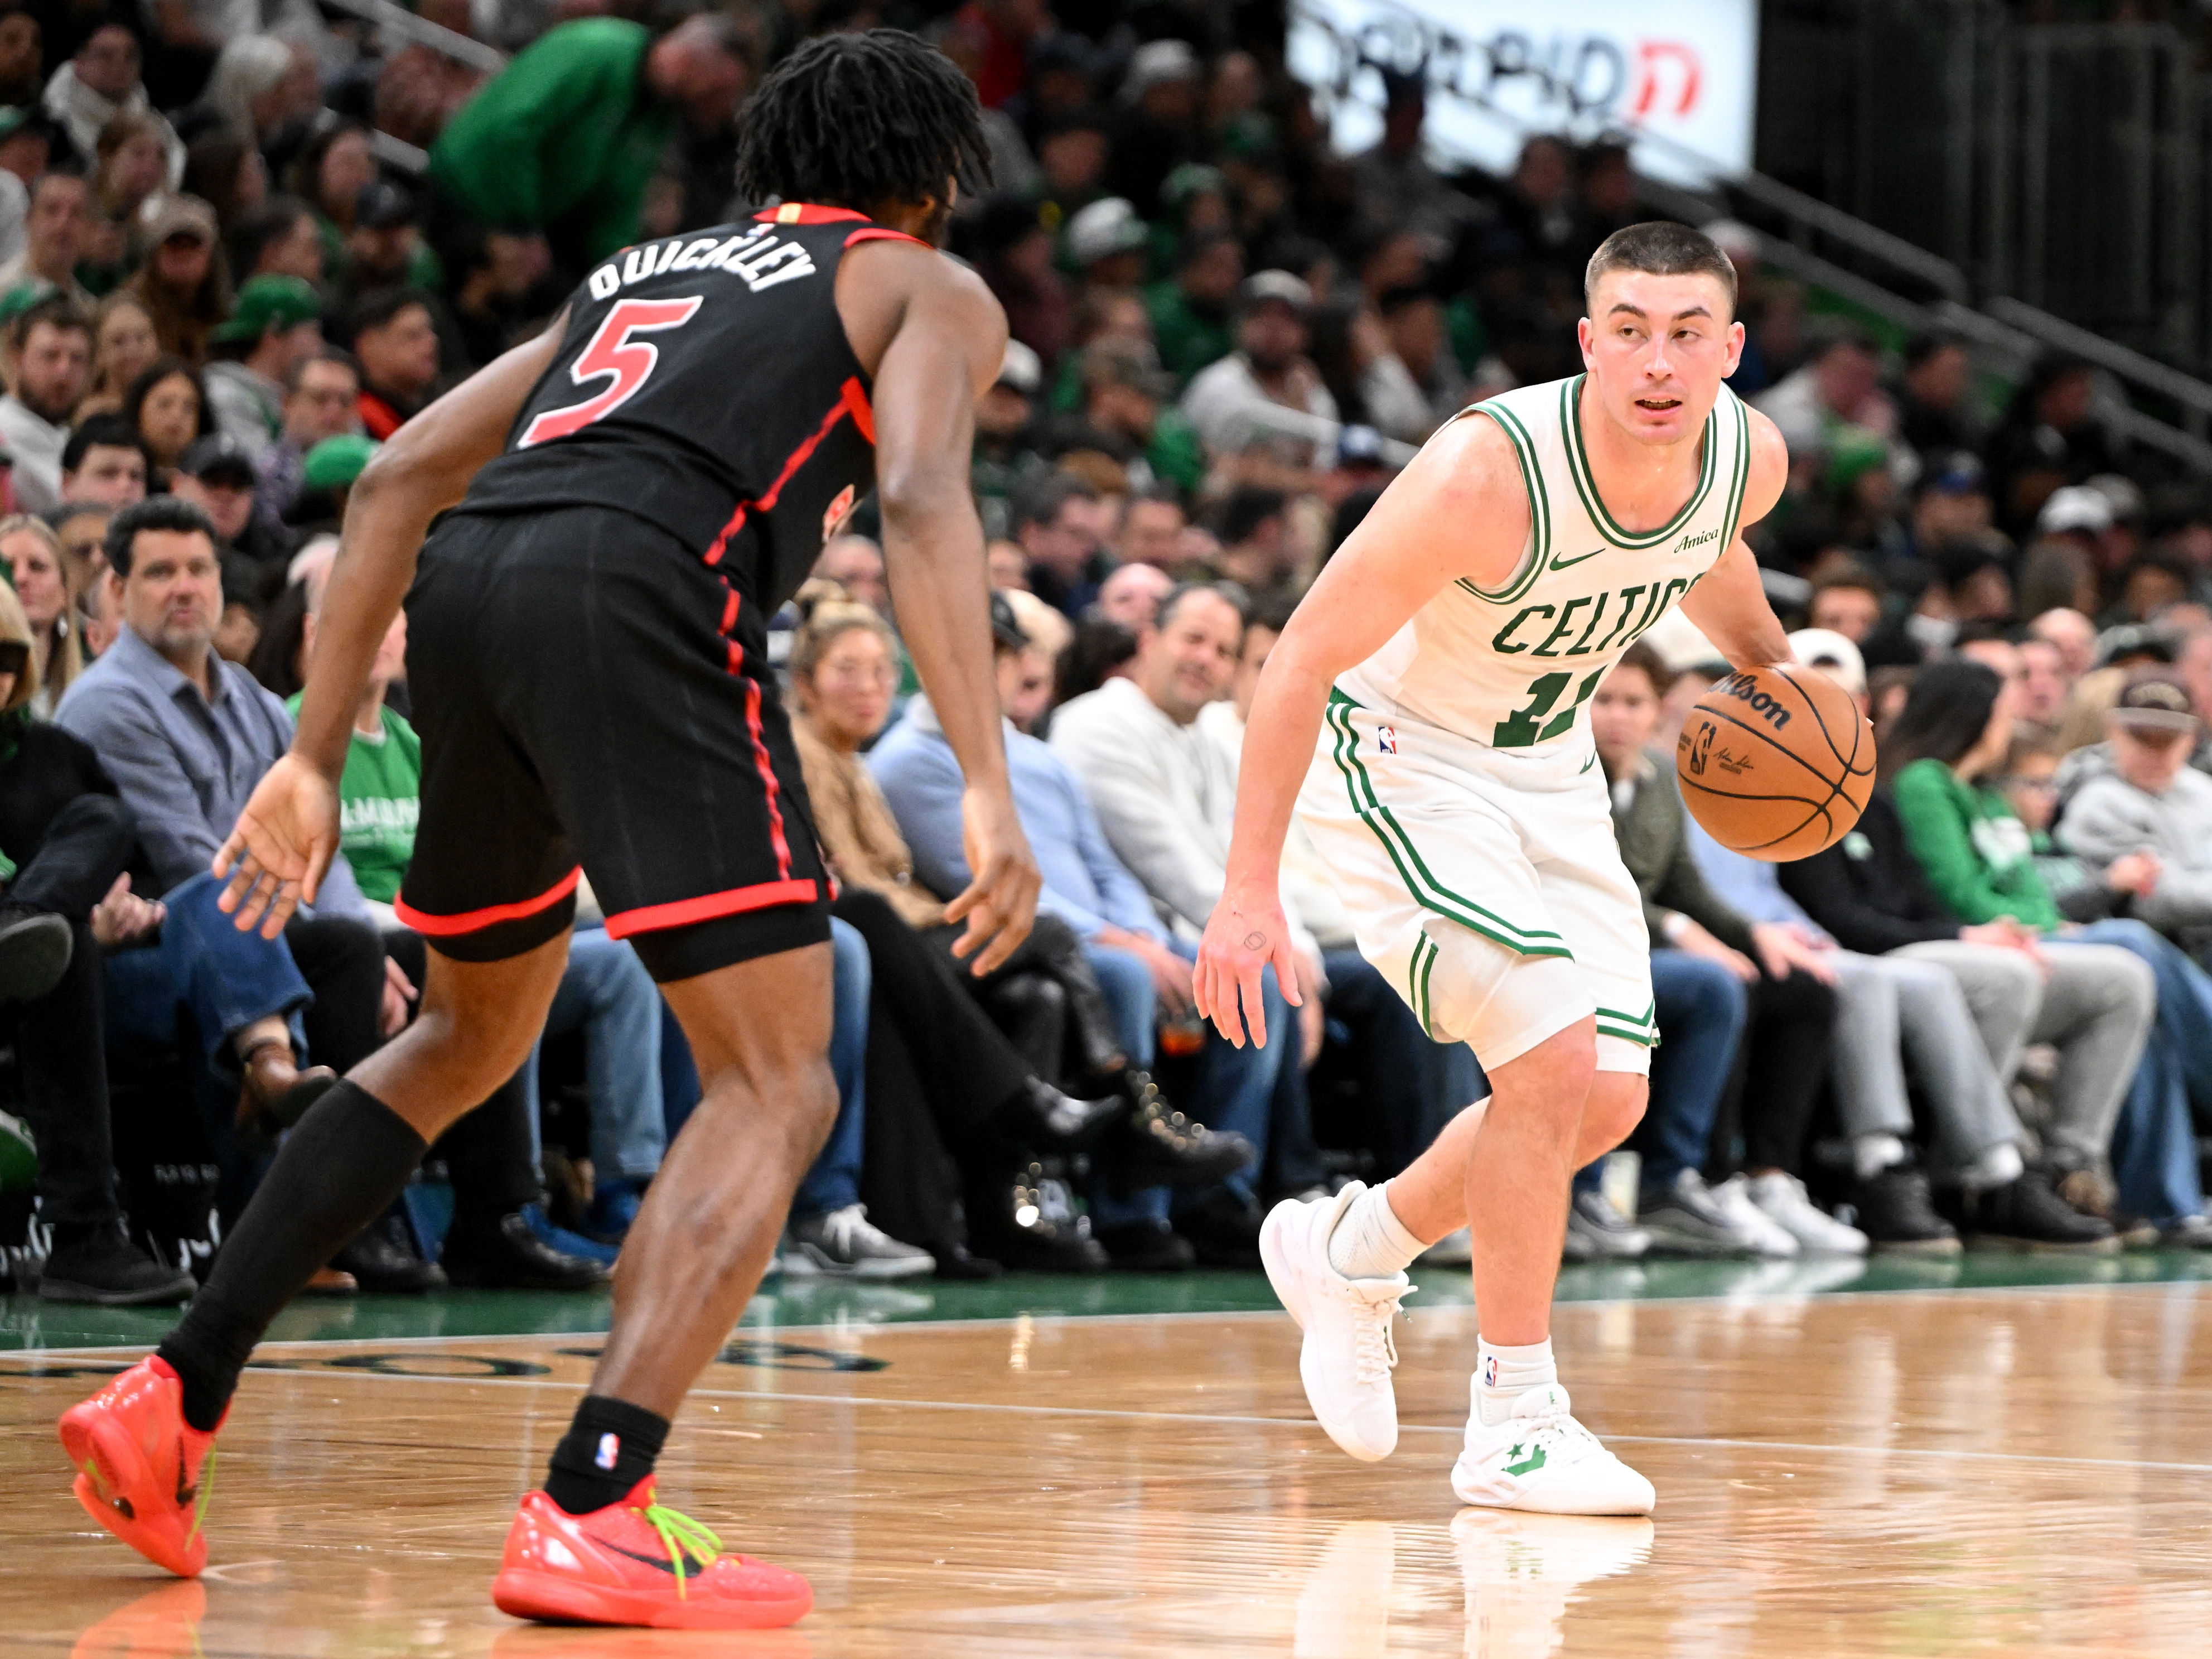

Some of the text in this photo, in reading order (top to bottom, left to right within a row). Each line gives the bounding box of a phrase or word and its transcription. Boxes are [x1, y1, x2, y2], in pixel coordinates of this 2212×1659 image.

[588, 235, 817, 301] QUICKLEY
[517, 295, 704, 449] 5
[1674, 528, 1719, 554] Amica
